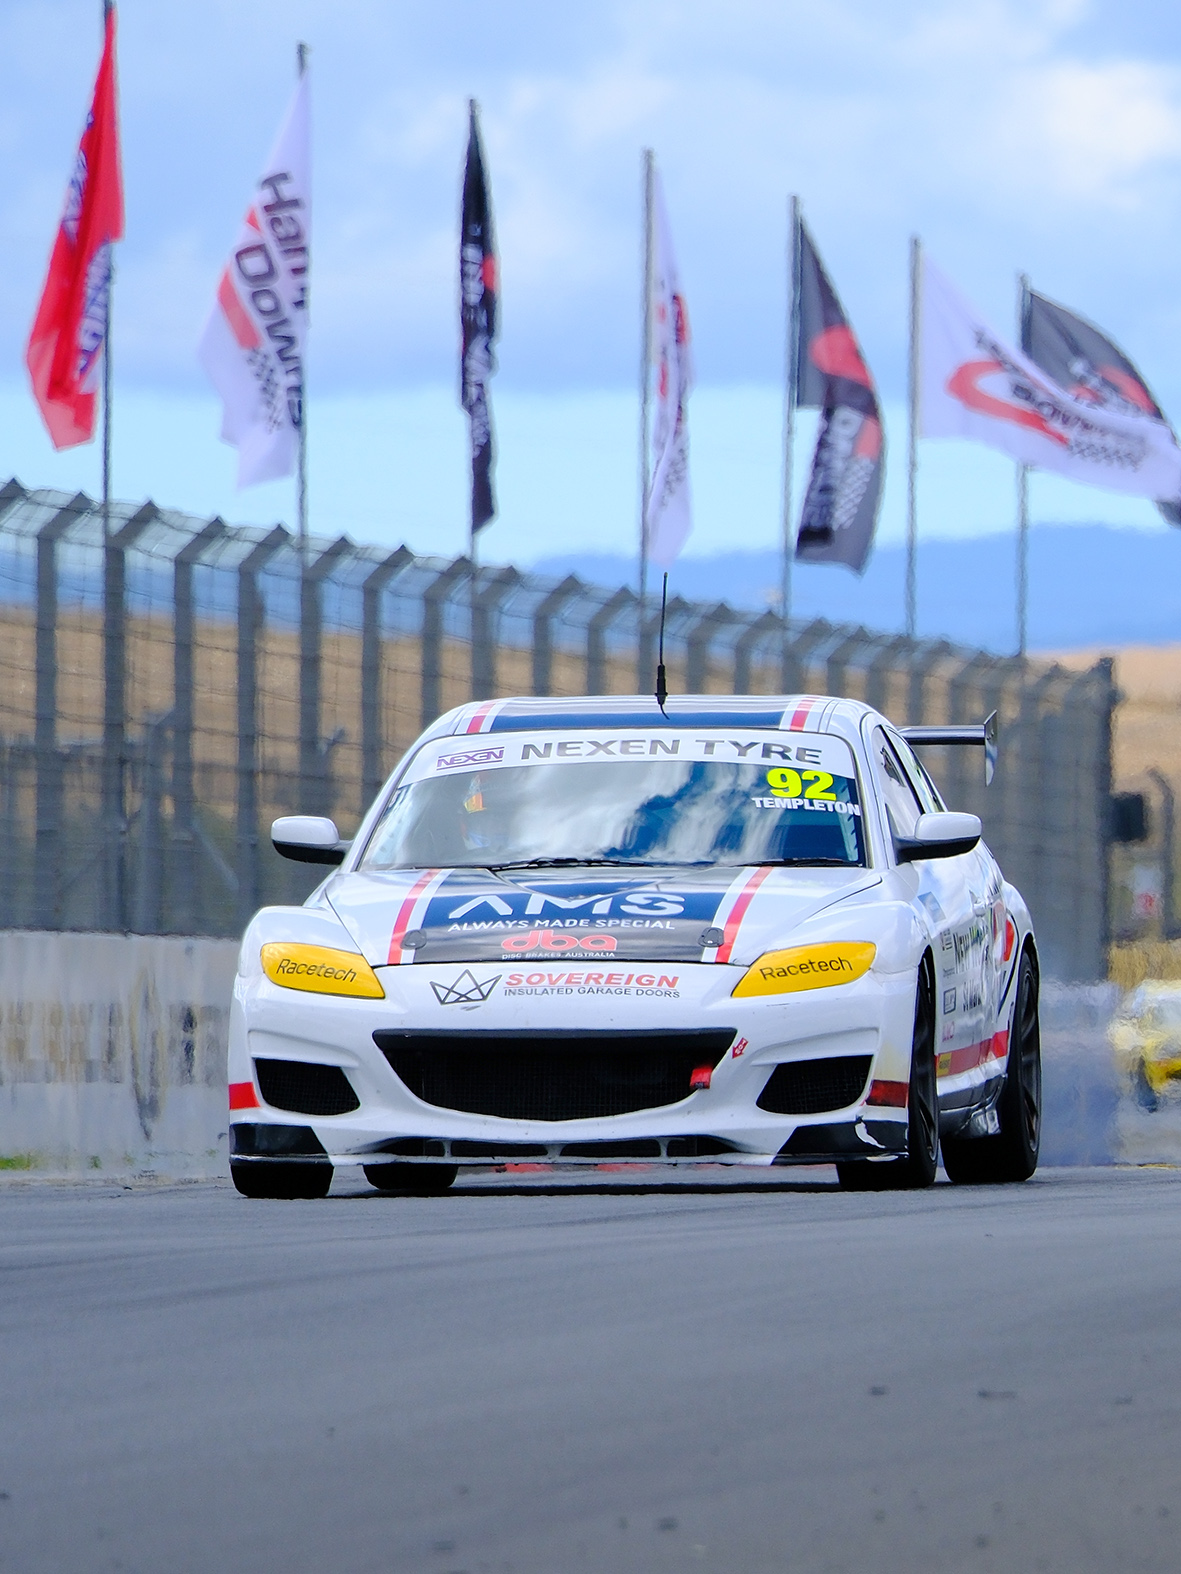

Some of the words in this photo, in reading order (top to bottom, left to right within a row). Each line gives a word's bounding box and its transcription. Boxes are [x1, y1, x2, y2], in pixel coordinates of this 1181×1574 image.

[437, 749, 504, 768] NEXEN
[521, 739, 679, 760] NEXEN
[695, 739, 822, 765] TYRE
[766, 767, 837, 802] 92
[751, 797, 861, 817] TEMPLETON
[448, 893, 685, 920] AMS
[447, 920, 530, 933] ALWAYS
[534, 918, 589, 930] MADE
[595, 919, 676, 930] SPECIAL
[501, 929, 618, 952] dba
[525, 951, 561, 959] BRAKES
[276, 958, 358, 983] Racetech
[759, 956, 854, 981] Racetech
[505, 972, 680, 989] SOVEREIGN
[504, 986, 573, 998] INSULATED
[577, 986, 632, 997] GARAGE
[635, 988, 681, 999] DOORS
